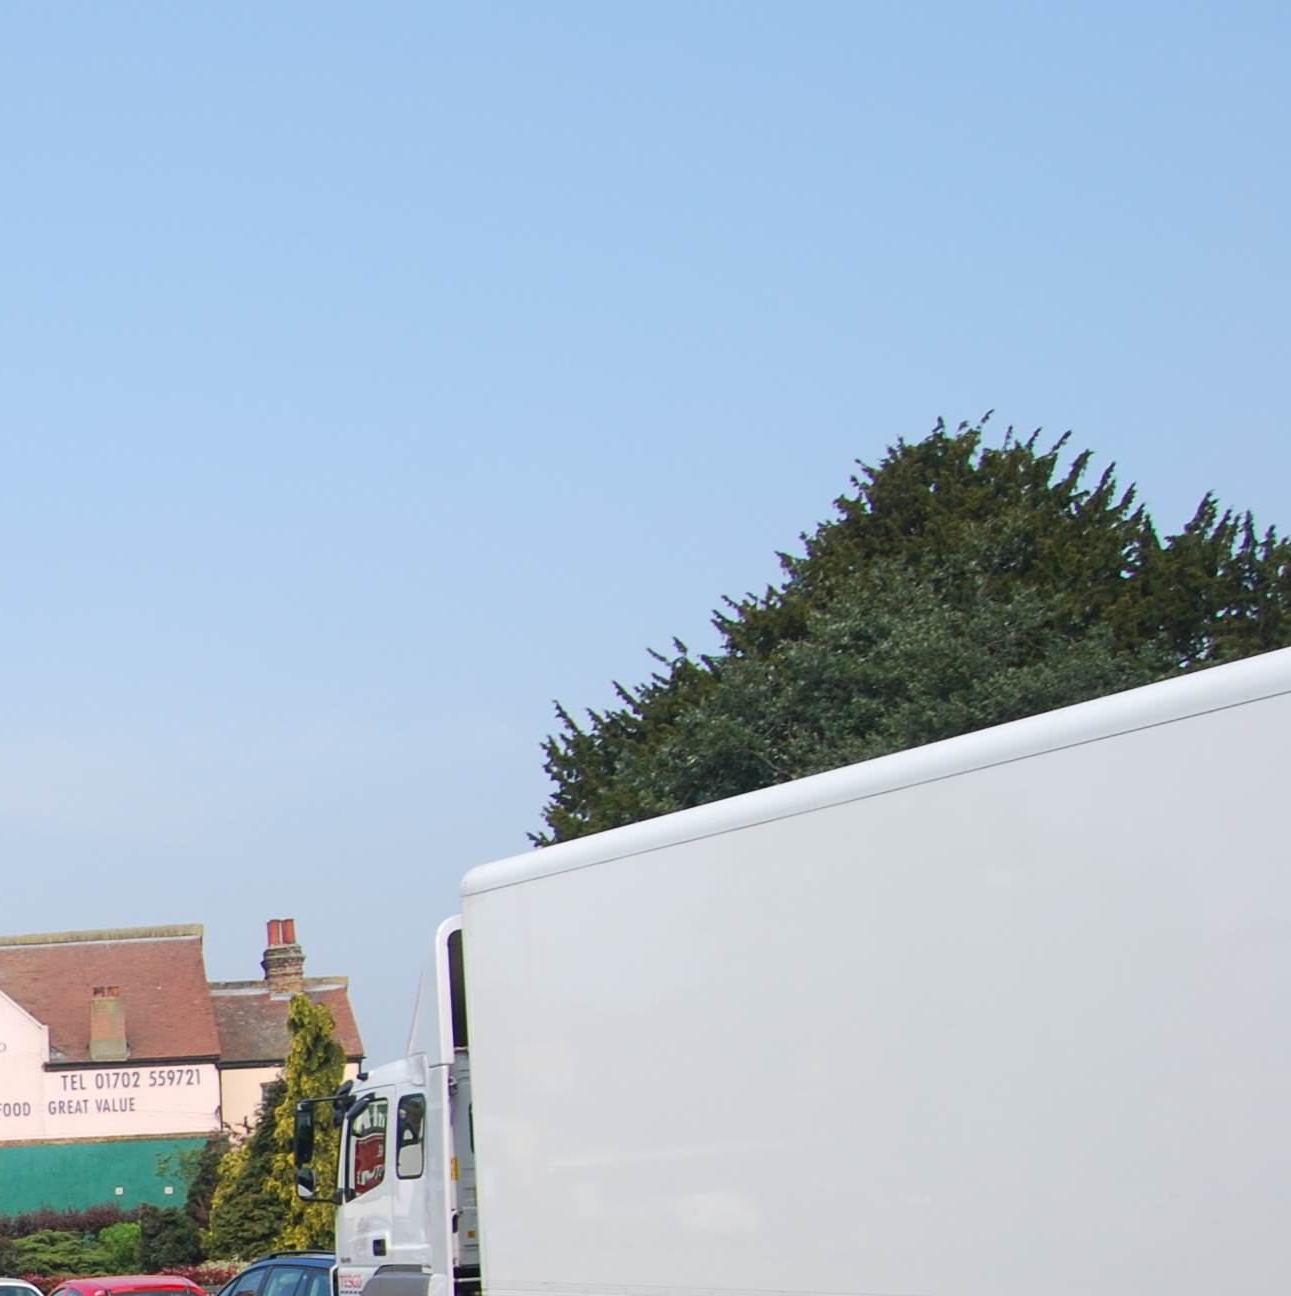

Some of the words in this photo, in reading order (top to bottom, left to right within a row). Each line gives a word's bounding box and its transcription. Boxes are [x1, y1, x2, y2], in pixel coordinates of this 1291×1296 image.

[60, 1074, 87, 1091] TEL
[95, 1071, 141, 1090] 01702
[148, 1069, 201, 1087] 559721
[48, 1100, 89, 1115] GREAT
[95, 1098, 136, 1113] VALUE
[339, 1274, 363, 1288] TESCO
